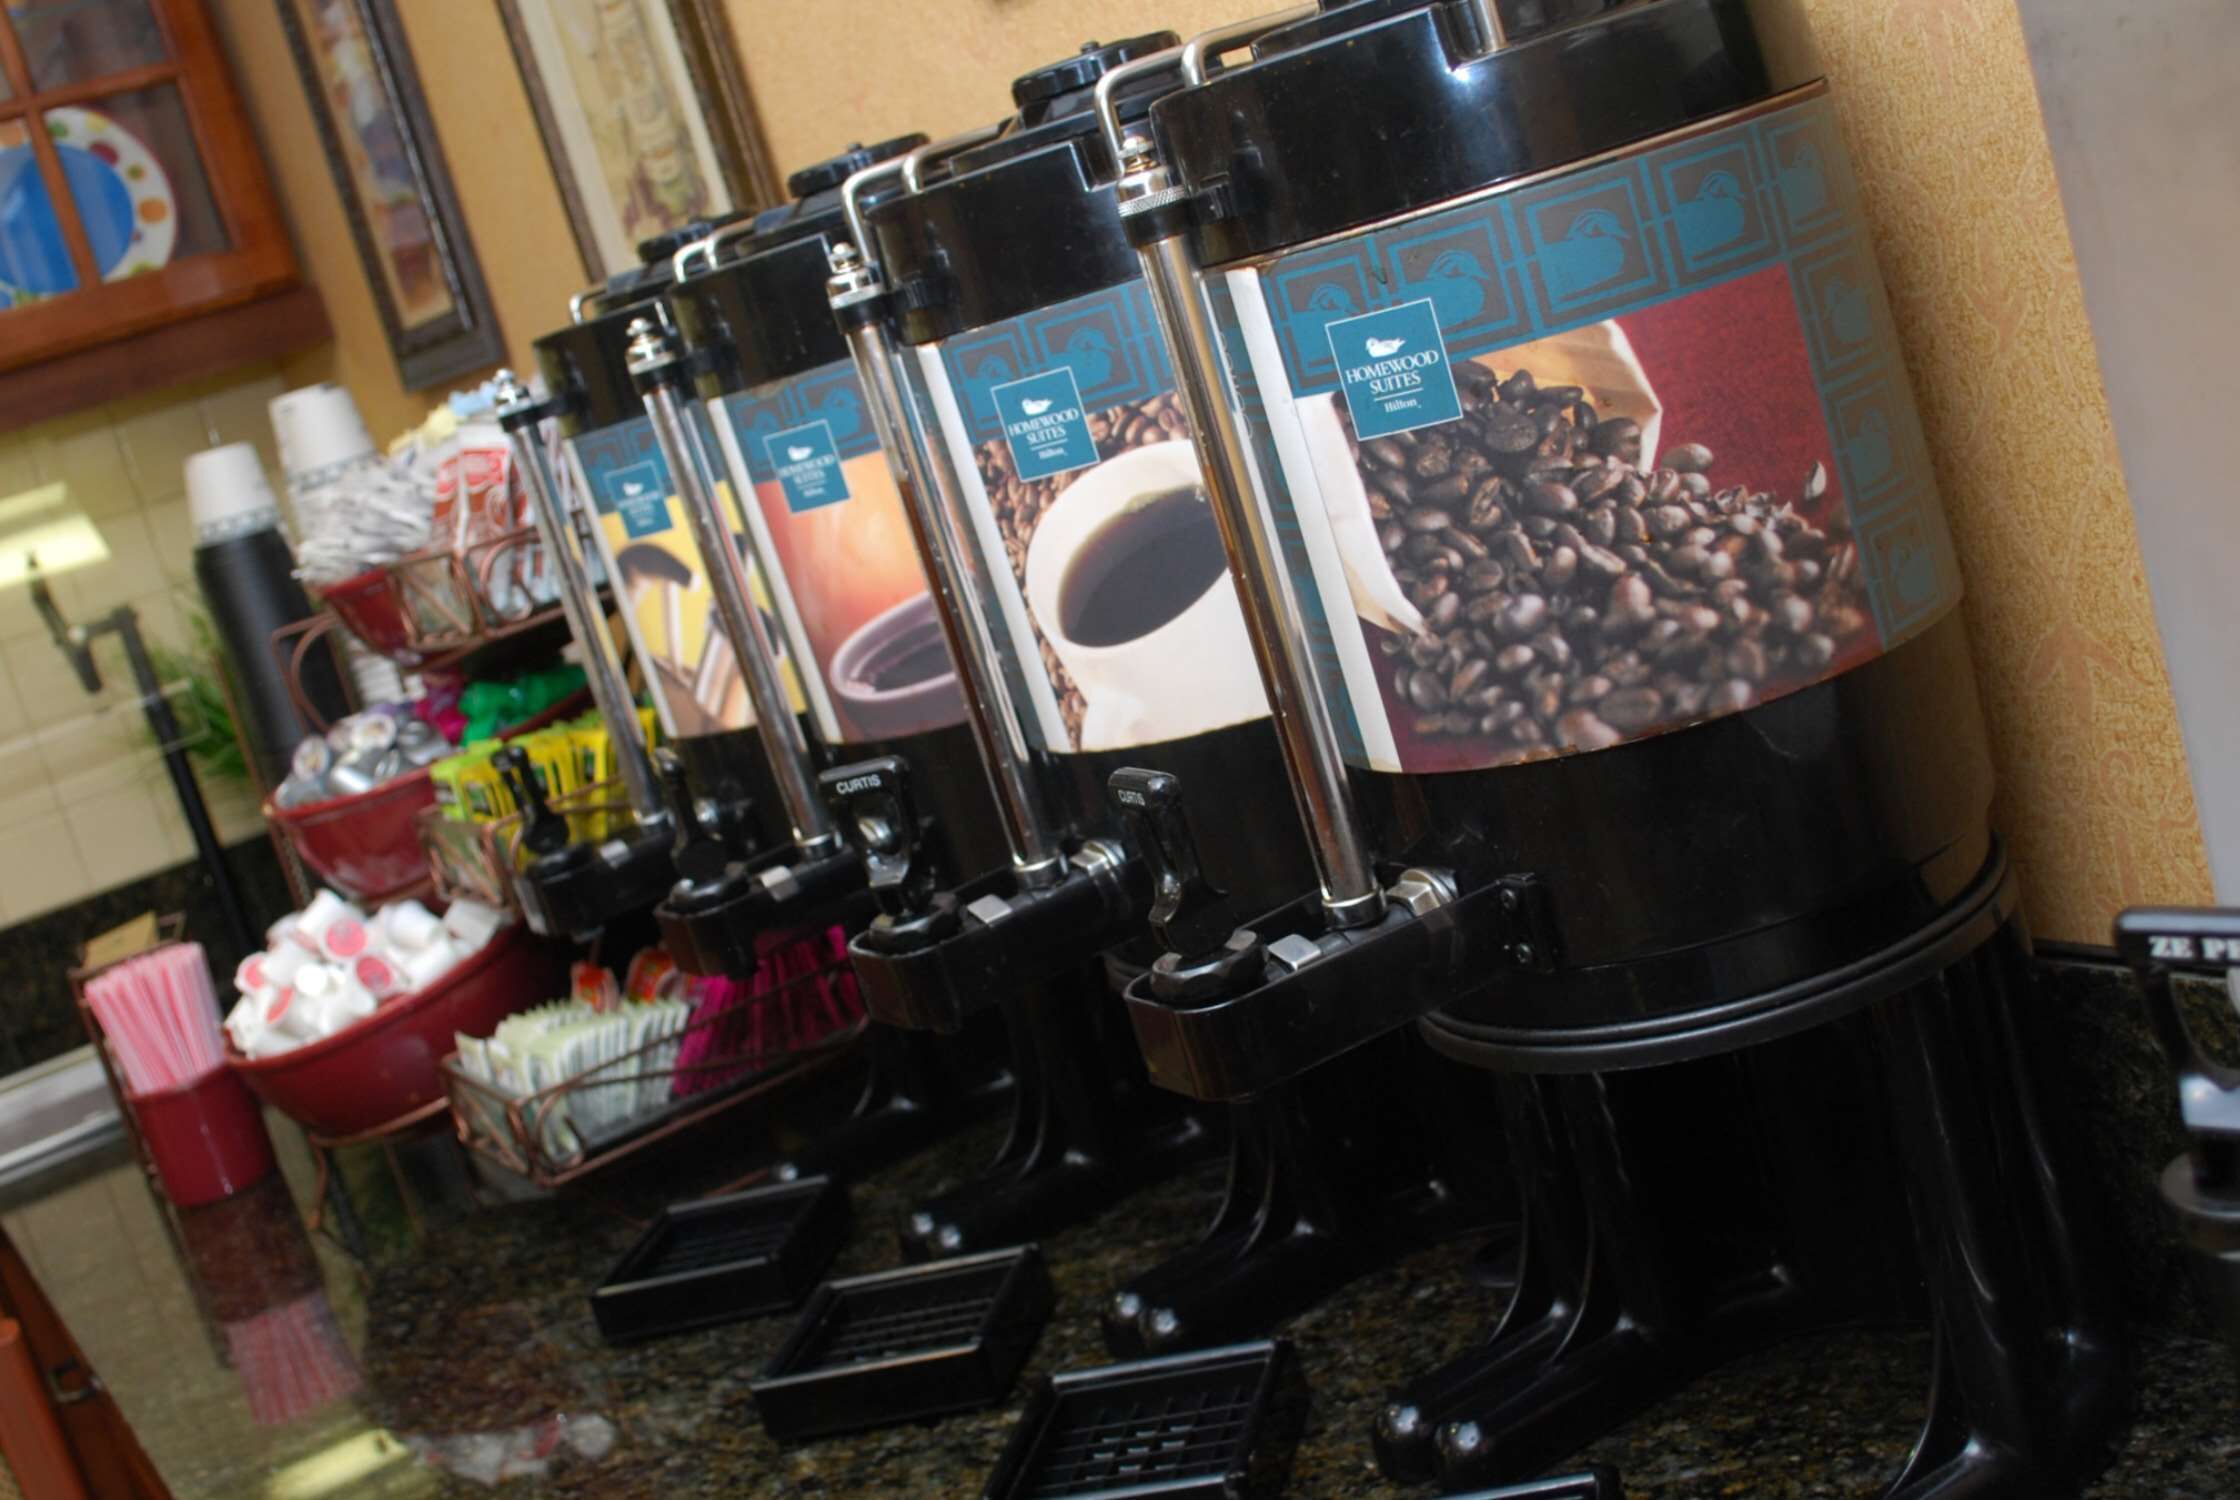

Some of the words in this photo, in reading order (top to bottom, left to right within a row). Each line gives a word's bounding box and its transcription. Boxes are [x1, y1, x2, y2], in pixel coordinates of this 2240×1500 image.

[1345, 350, 1440, 384] HOMEWOOD
[1369, 370, 1422, 394] SUITES
[1384, 398, 1418, 413] Hilton
[1007, 407, 1080, 437] HOMEWOOD
[1026, 424, 1067, 445] SUITES
[836, 774, 882, 795] CURTIS
